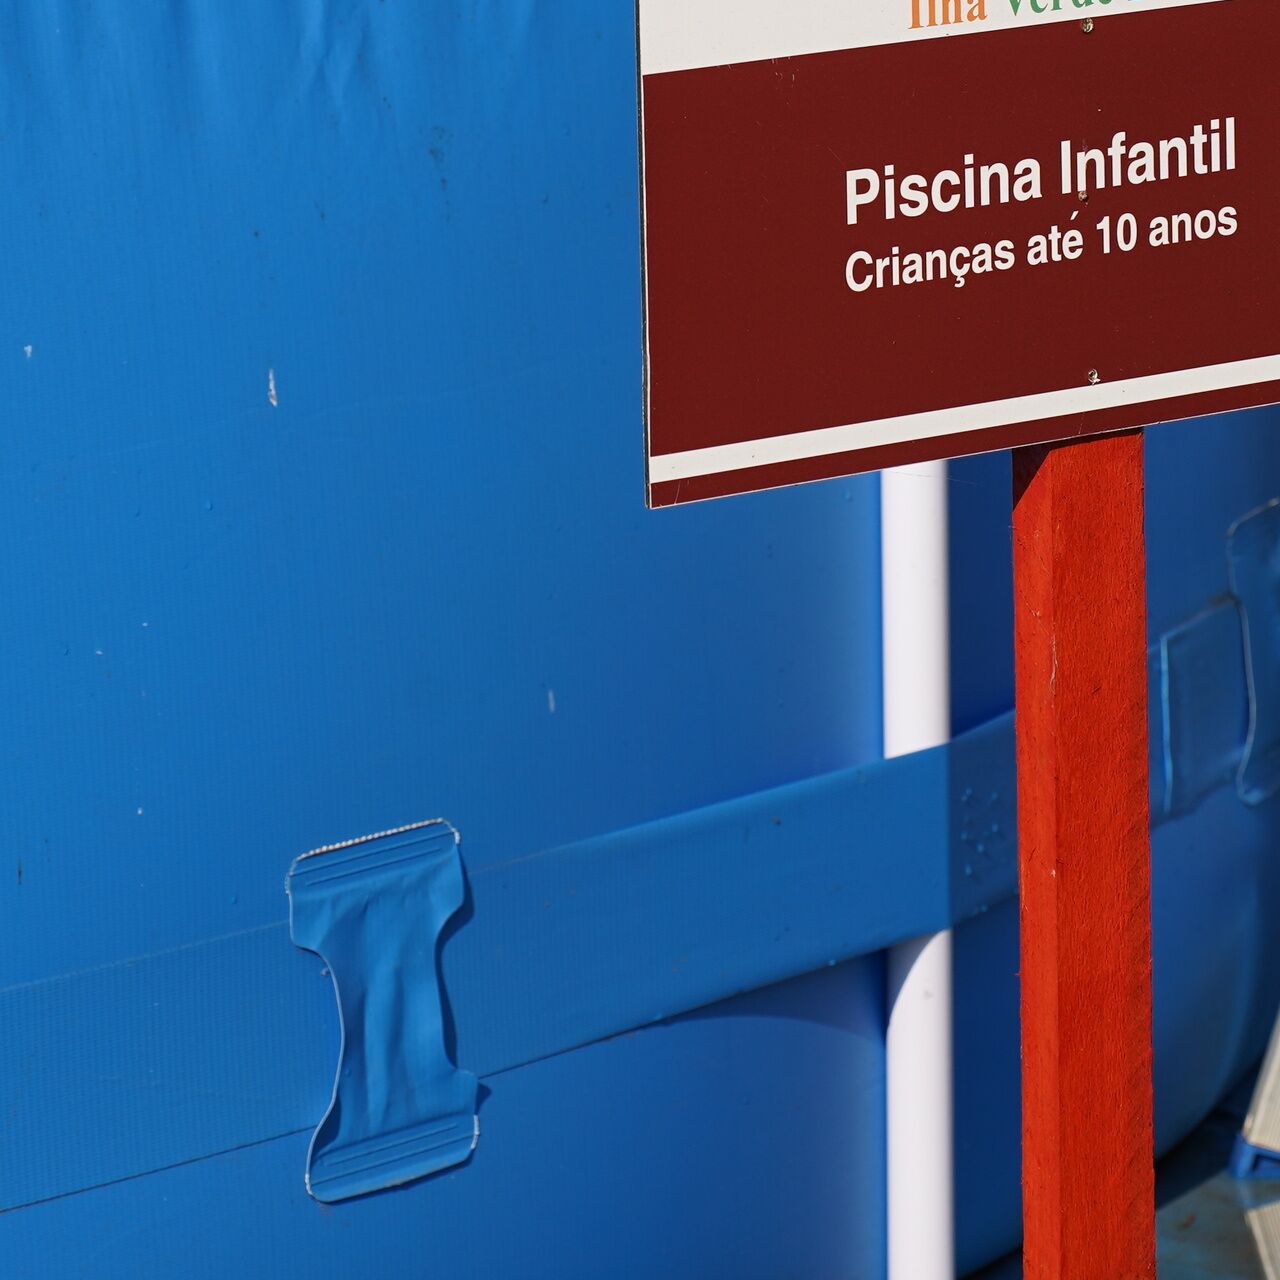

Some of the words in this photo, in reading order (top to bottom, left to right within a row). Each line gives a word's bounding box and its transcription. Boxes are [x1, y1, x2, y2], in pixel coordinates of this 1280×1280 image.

[846, 153, 1042, 226] Piscina
[1060, 116, 1236, 195] Infantil
[845, 239, 1016, 292] Crianças
[1026, 210, 1084, 266] até
[1096, 212, 1138, 254] 10
[1148, 206, 1238, 247] anos
